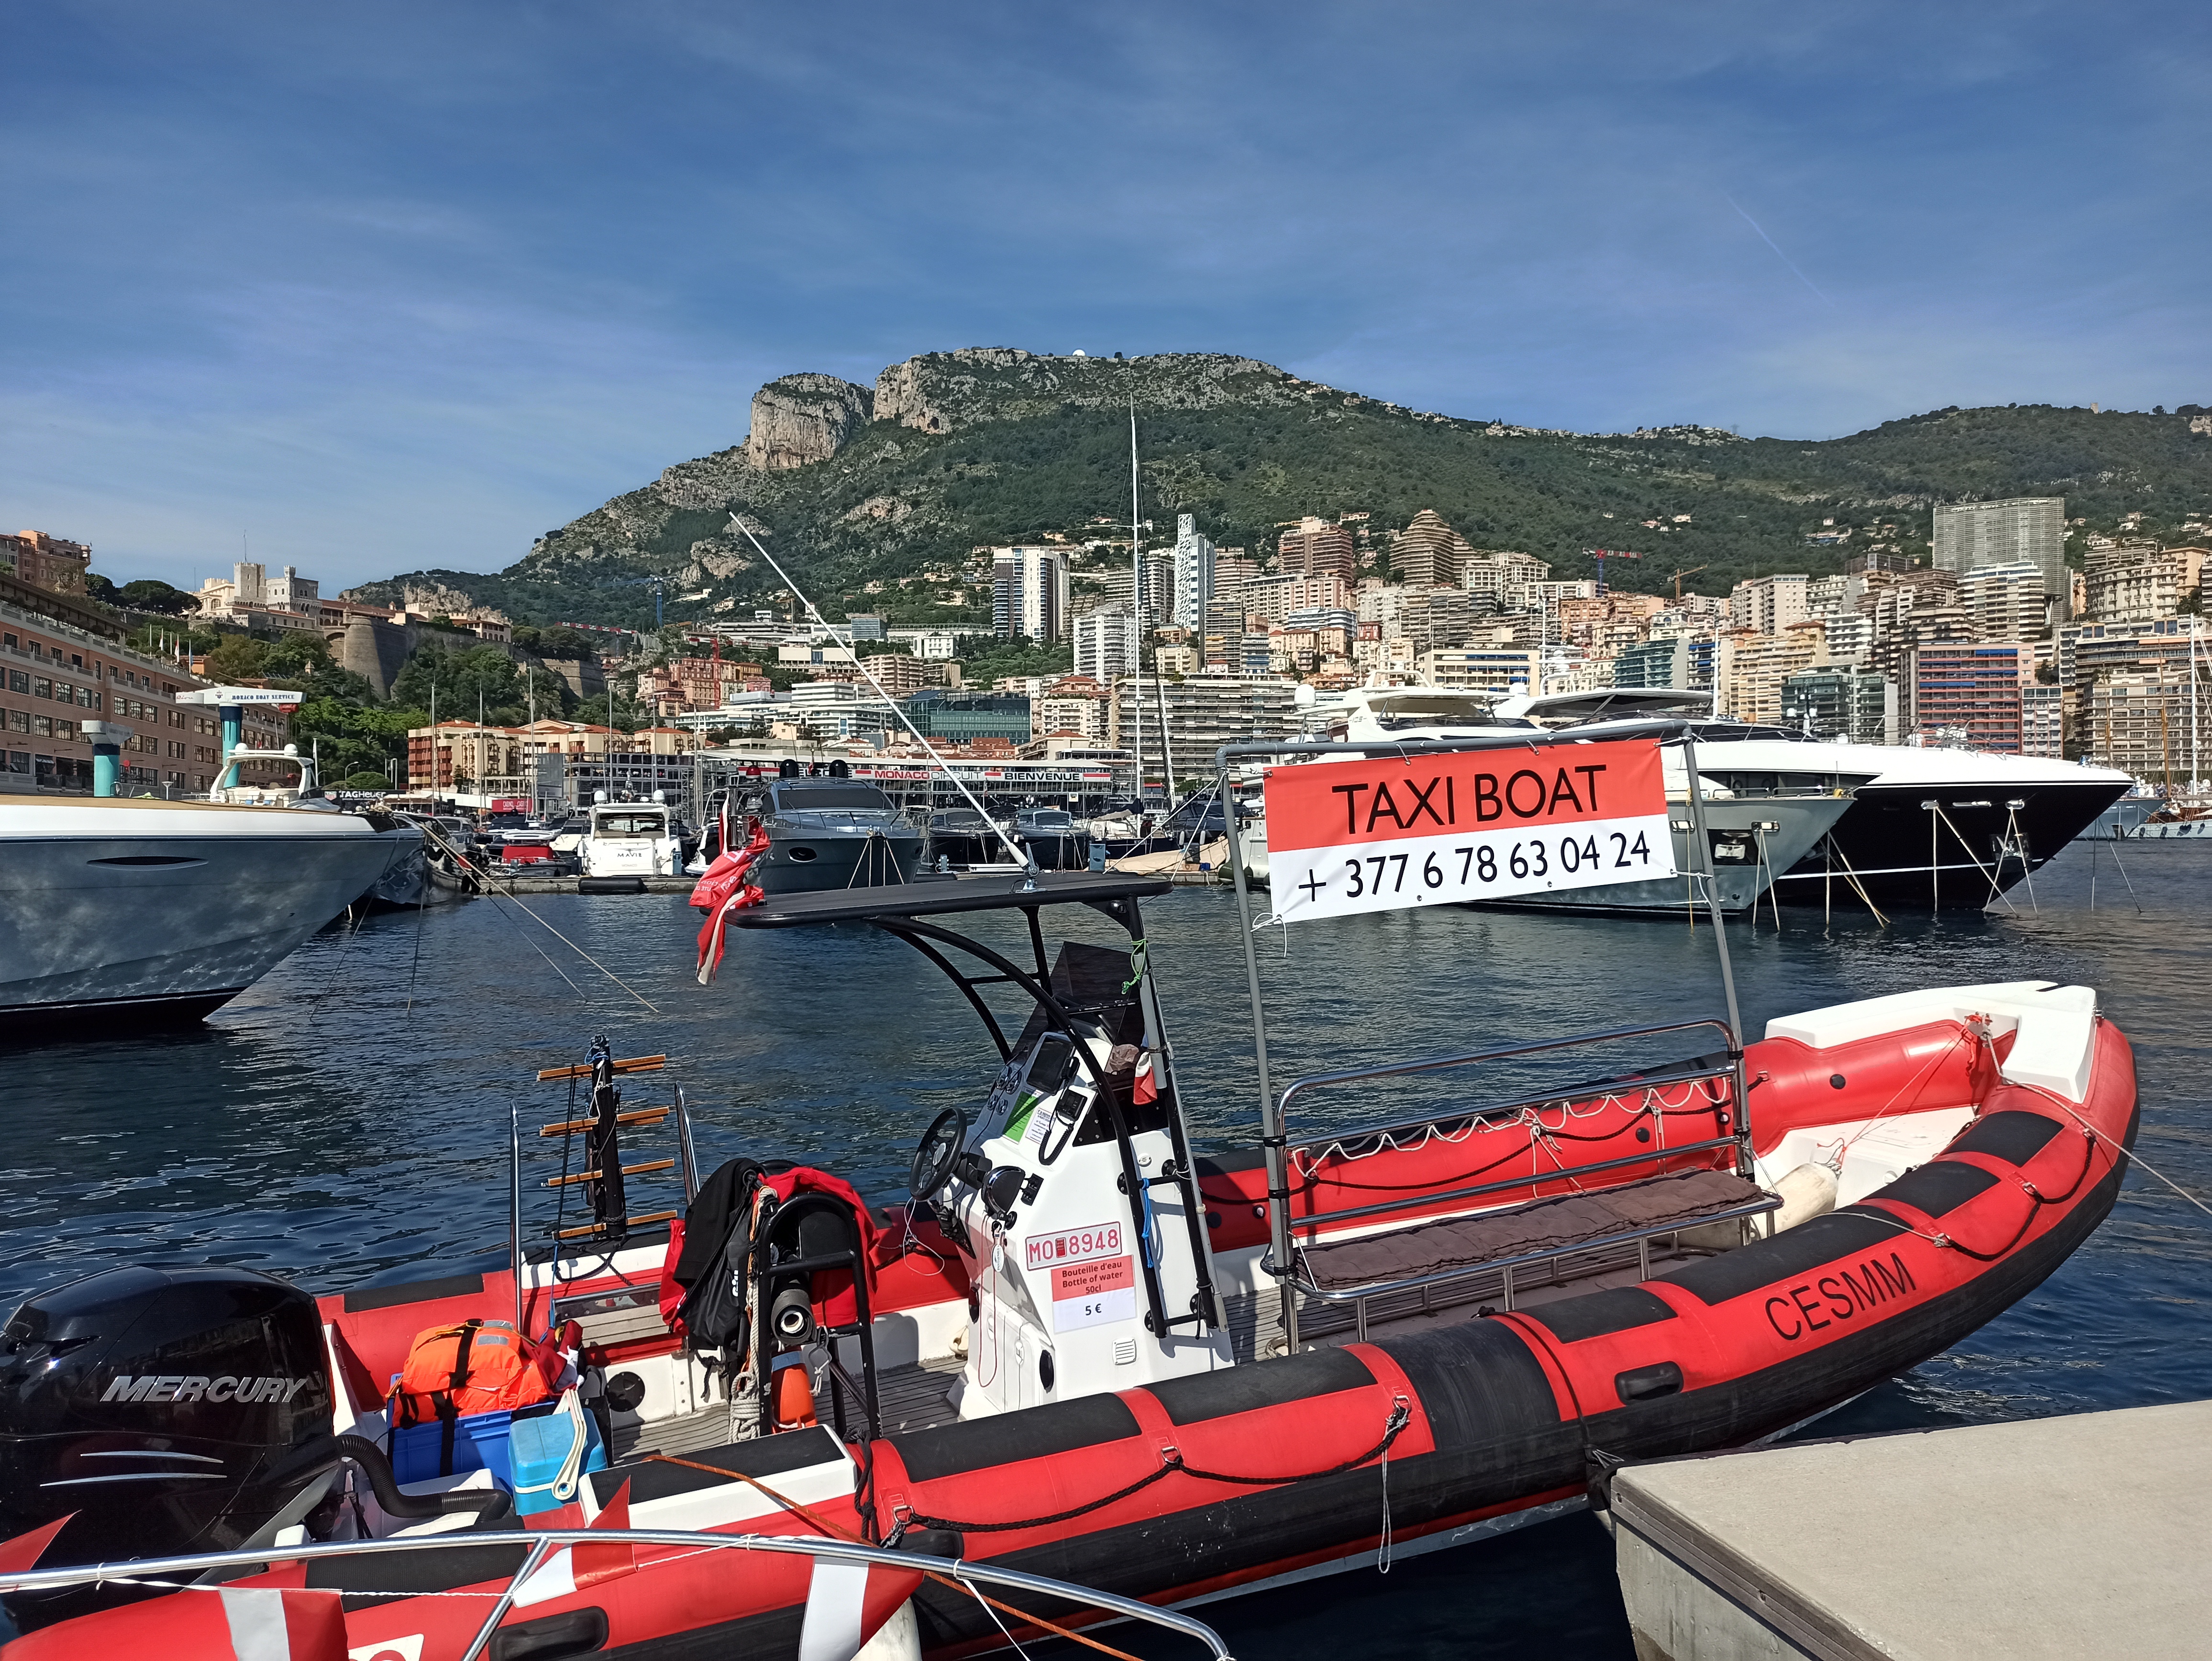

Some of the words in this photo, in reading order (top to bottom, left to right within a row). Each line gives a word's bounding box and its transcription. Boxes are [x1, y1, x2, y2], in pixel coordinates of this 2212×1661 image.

[874, 770, 929, 779] MONACO
[1005, 773, 1080, 781] BIENVENUE
[1332, 776, 1455, 834] TAXI
[1475, 764, 1606, 822] BOAT
[1298, 869, 1327, 902] +
[1346, 853, 1409, 898] 377
[1424, 851, 1443, 889] 6
[1455, 845, 1498, 885] 78
[1510, 840, 1548, 879] 63
[1560, 836, 1600, 873] 04
[1610, 830, 1650, 867] 24
[1029, 1240, 1053, 1263] MO
[1069, 1229, 1118, 1254] 8948
[1062, 1265, 1098, 1277] Bouteille
[1100, 1262, 1122, 1271] d'eau
[1062, 1277, 1087, 1288] Bottle
[1099, 1271, 1123, 1281] water
[1085, 1284, 1101, 1294] 50cl
[1765, 1252, 1917, 1340] CESMM
[1085, 1306, 1092, 1316] 5
[1095, 1304, 1102, 1313] €
[100, 1375, 307, 1403] MERCURY
